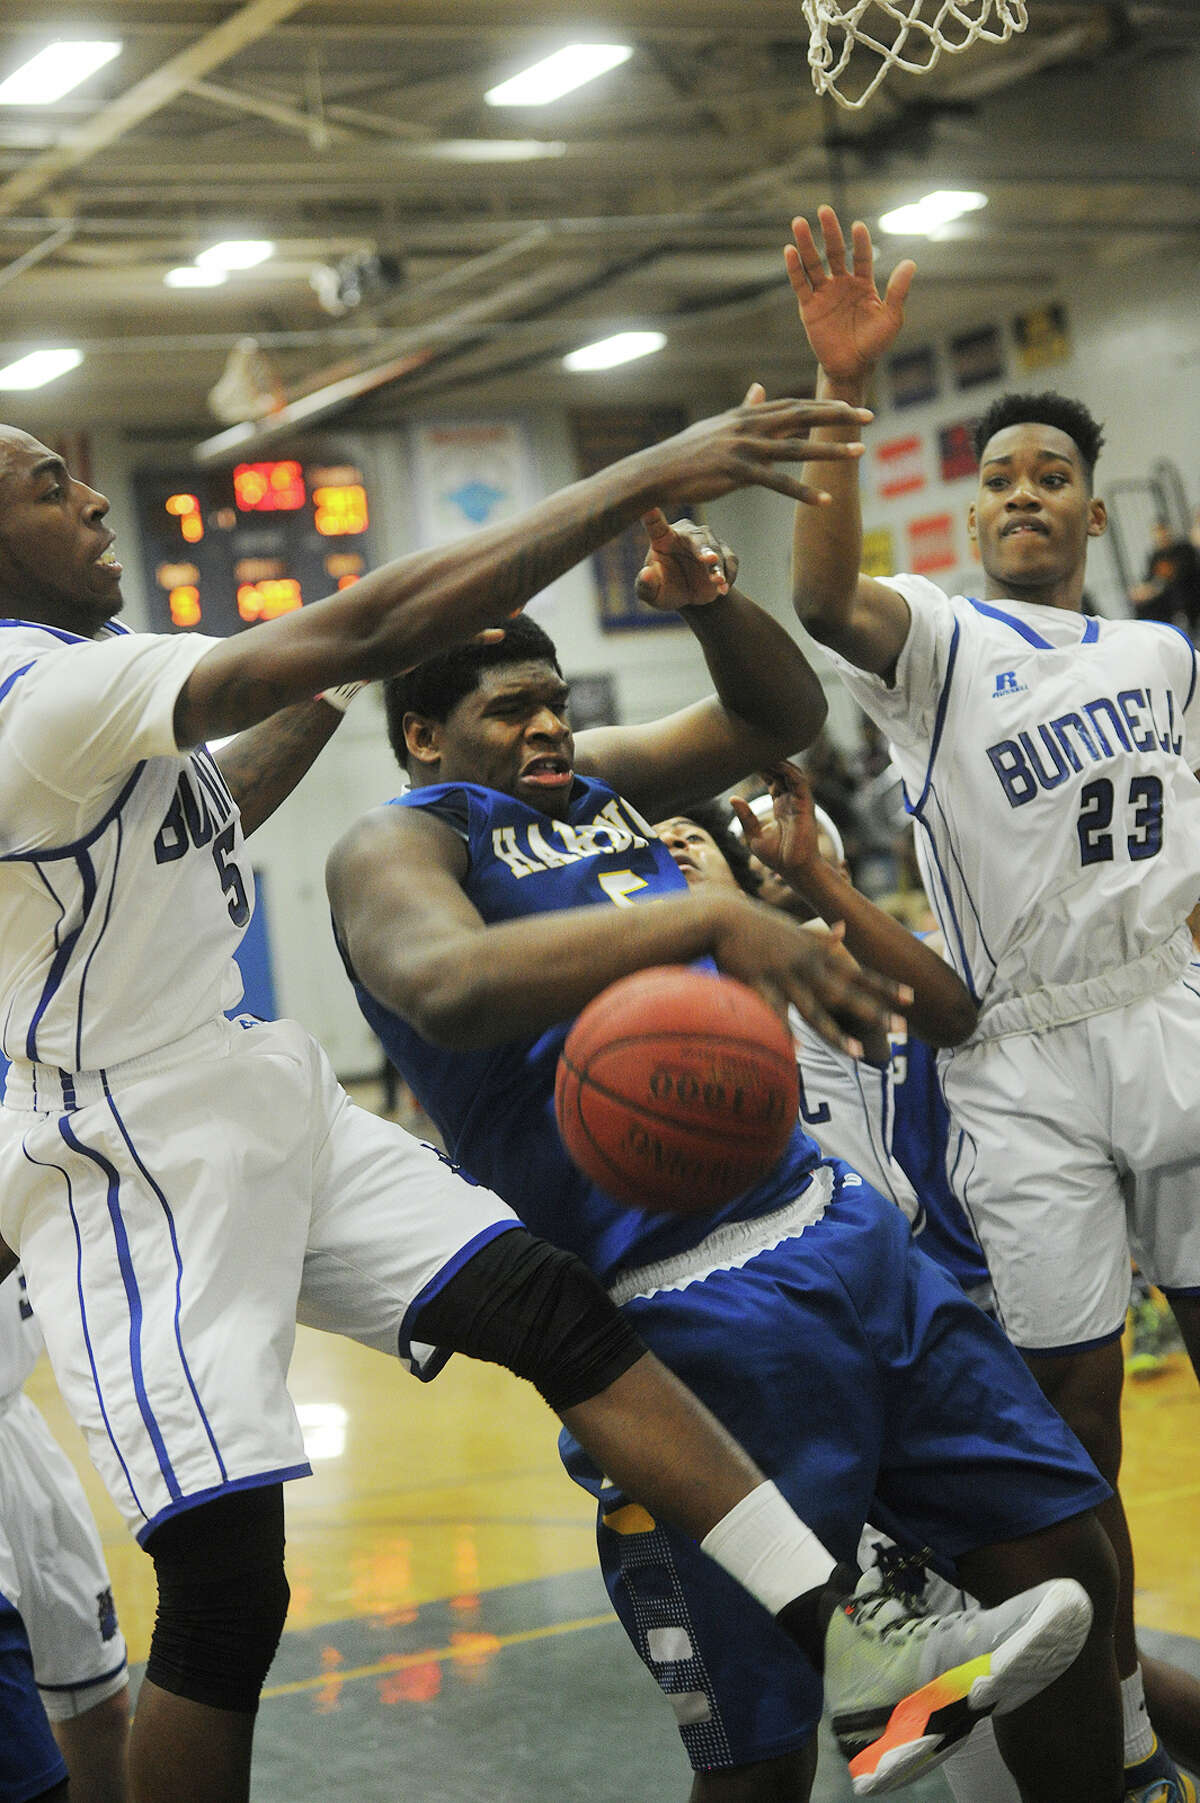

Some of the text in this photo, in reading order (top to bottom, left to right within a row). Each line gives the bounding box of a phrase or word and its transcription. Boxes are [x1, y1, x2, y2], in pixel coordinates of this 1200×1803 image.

[985, 687, 1183, 808] BUNNELL
[212, 820, 251, 928] 5
[1076, 775, 1164, 868] 23
